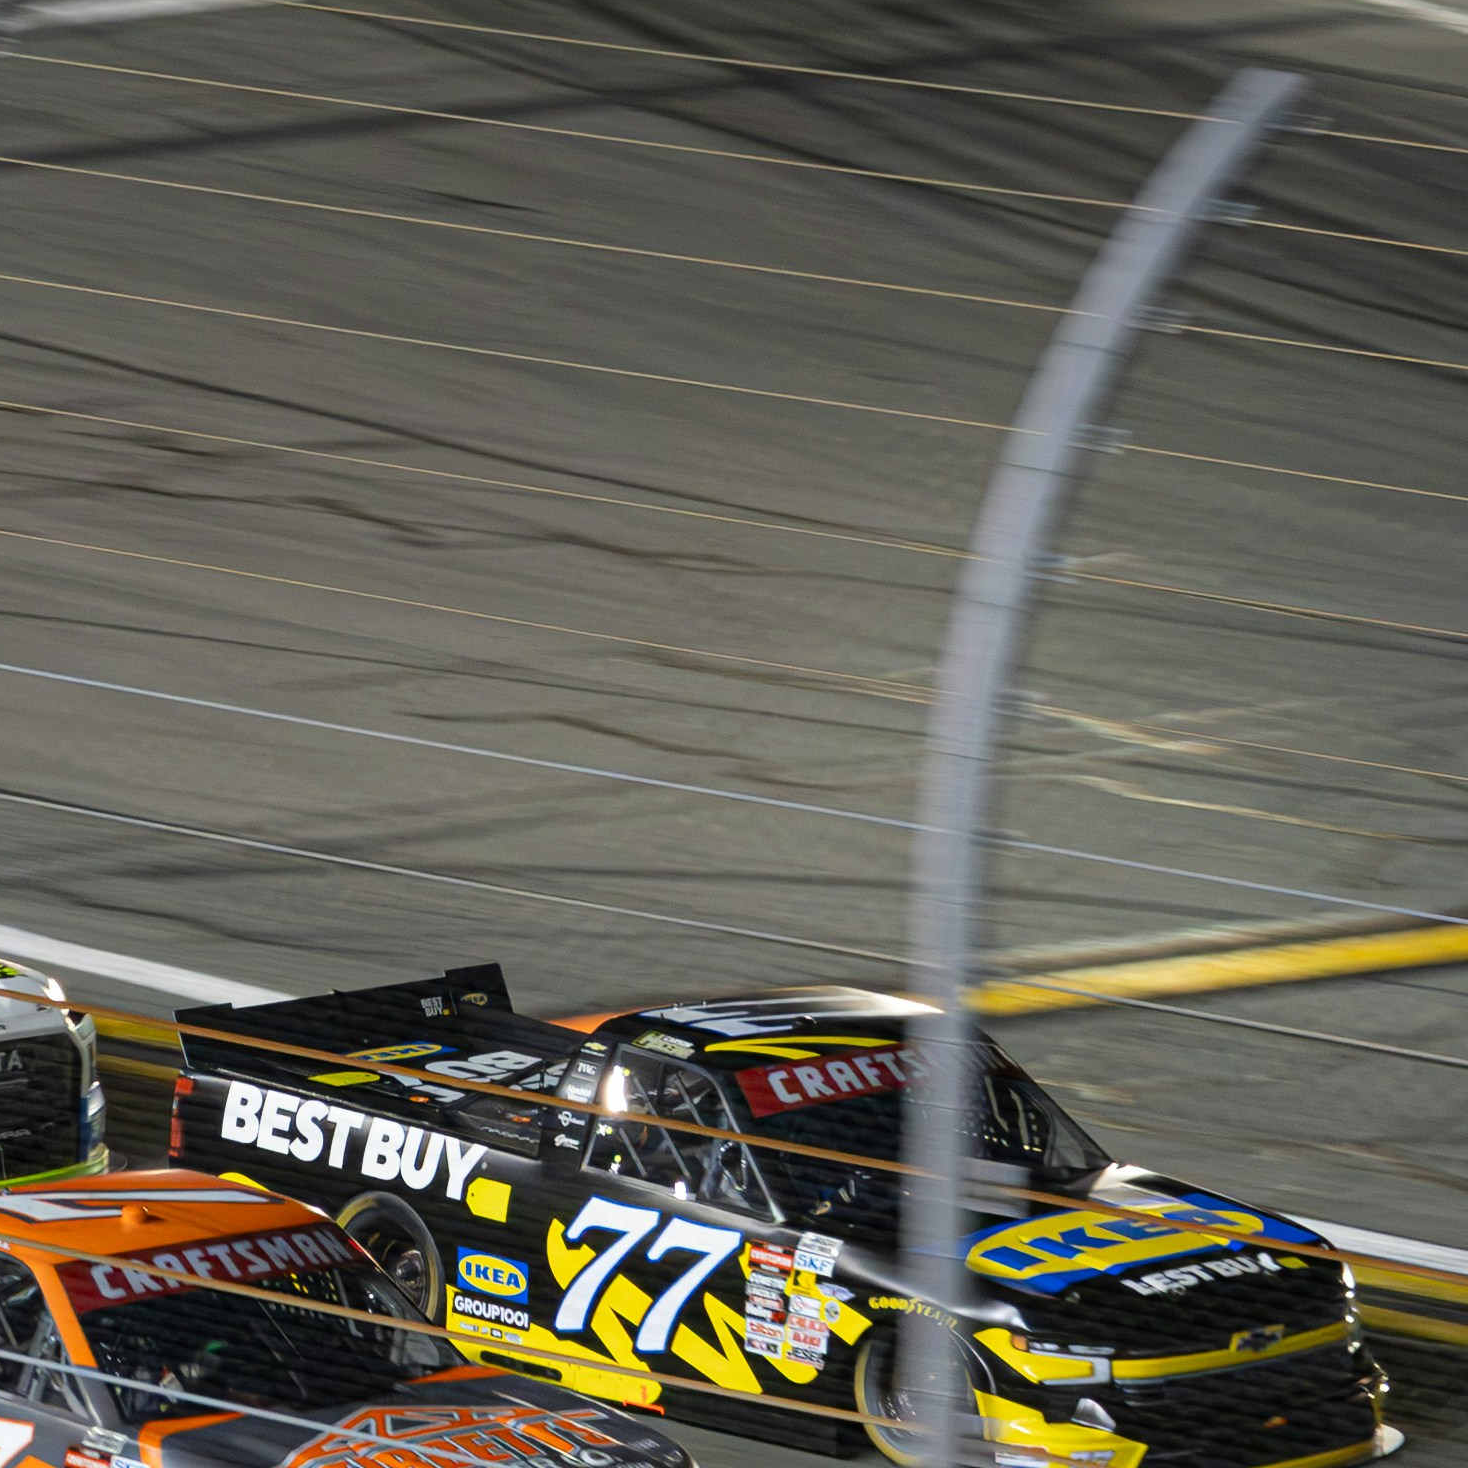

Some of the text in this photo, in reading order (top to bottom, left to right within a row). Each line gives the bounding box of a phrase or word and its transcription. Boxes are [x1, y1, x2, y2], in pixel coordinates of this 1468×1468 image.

[220, 1081, 488, 1200] BEST BUY
[89, 1229, 352, 1300] CRAFTSMAN
[465, 1261, 521, 1289] IKEA
[553, 1196, 742, 1354] 77
[797, 1254, 831, 1273] SKF
[454, 1295, 529, 1329] GROUP1001
